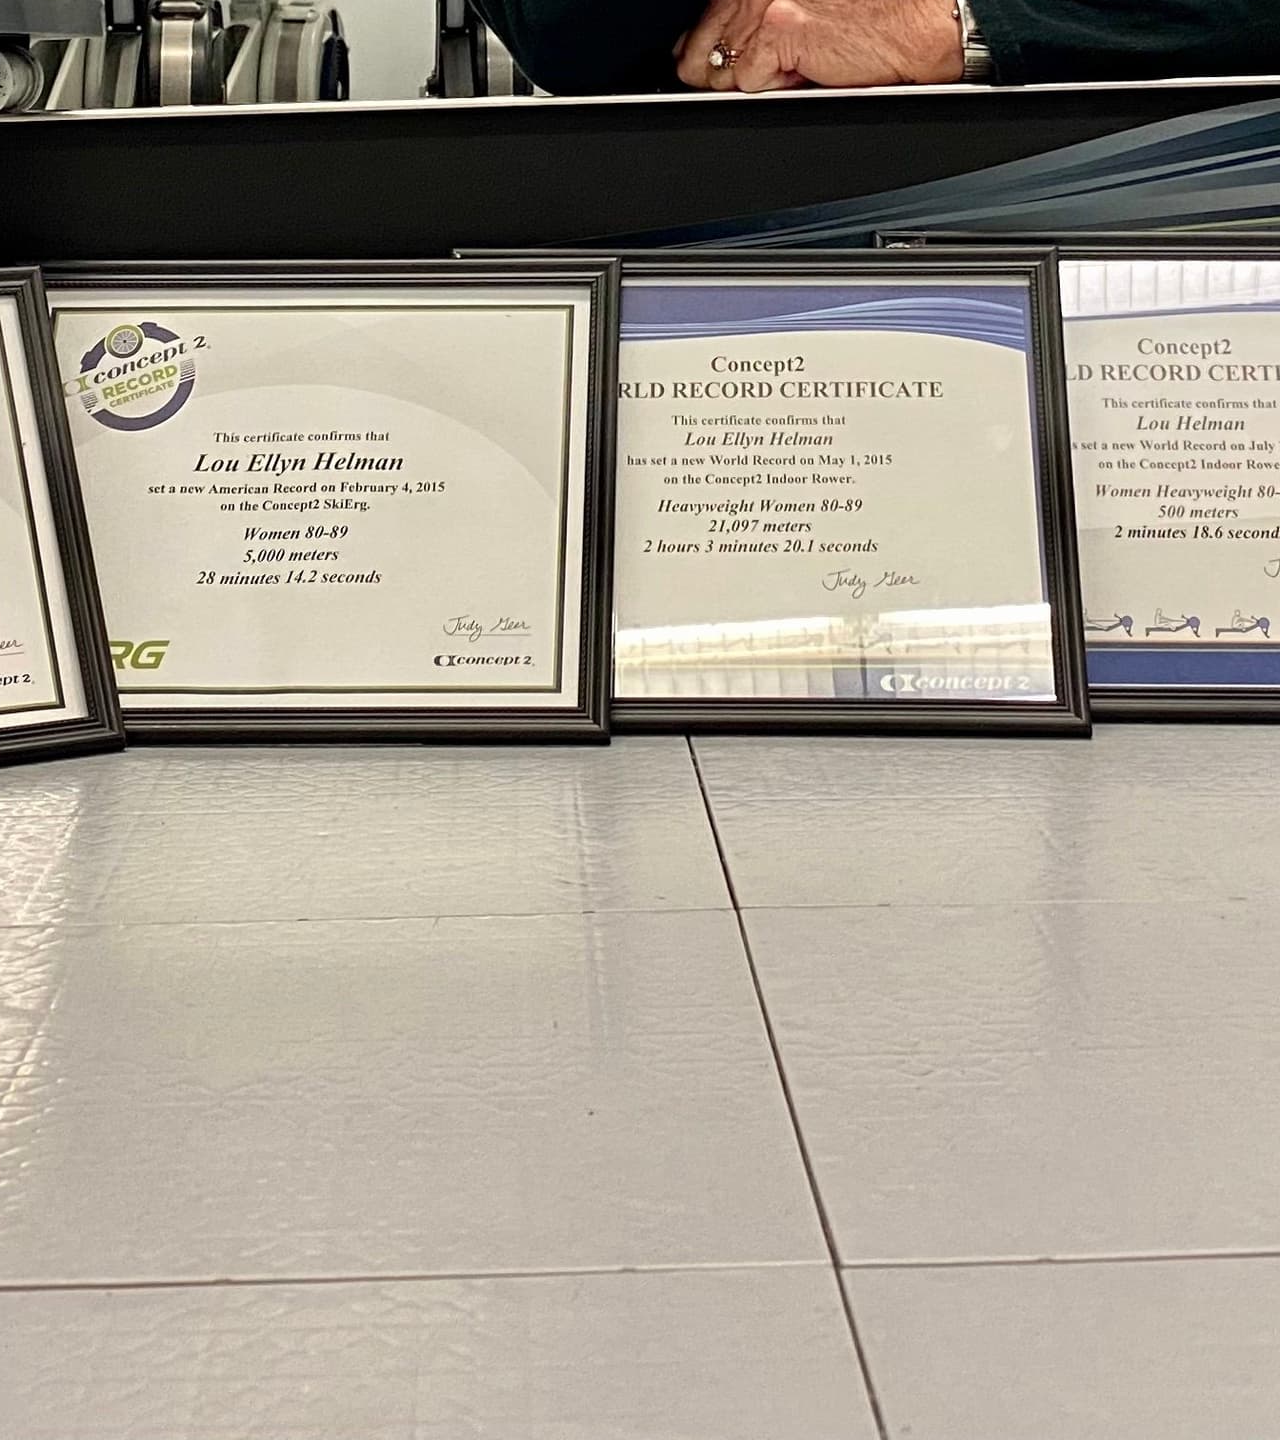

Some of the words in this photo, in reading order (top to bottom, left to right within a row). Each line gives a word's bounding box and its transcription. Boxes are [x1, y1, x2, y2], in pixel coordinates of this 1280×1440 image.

[93, 342, 188, 385] concept
[710, 355, 805, 376] Concept2
[1100, 363, 1202, 381] RECORD
[101, 364, 178, 400] RECORD
[671, 381, 773, 398] RECORD
[779, 380, 944, 398] CERTIFICATE
[109, 379, 175, 408] CERTIFICATE
[193, 453, 240, 472] Lou
[245, 452, 307, 476] Ellyn
[311, 451, 404, 470] Helman
[657, 498, 755, 516] Heavyweight
[760, 498, 816, 512] Women
[820, 498, 863, 512] 80-89
[1157, 504, 1186, 518] 500
[1189, 507, 1239, 518] meters
[244, 526, 301, 540] Women
[304, 524, 349, 539] 80-89
[708, 519, 760, 534] 21,097
[762, 520, 813, 532] meters
[1114, 524, 1123, 538] 2
[1127, 524, 1187, 539] minutes
[643, 539, 653, 552] 2
[656, 539, 701, 552] hours
[704, 539, 714, 553] 3
[718, 538, 779, 552] minutes
[782, 538, 815, 552] 20.1
[818, 538, 879, 552] seconds
[242, 547, 286, 565] 5,000
[287, 548, 340, 562] meters
[196, 569, 217, 584] 28
[219, 570, 281, 585] minutes
[285, 568, 318, 584] 14.2
[320, 569, 382, 584] seconds
[457, 655, 521, 666] concept
[915, 674, 1013, 691] concept
